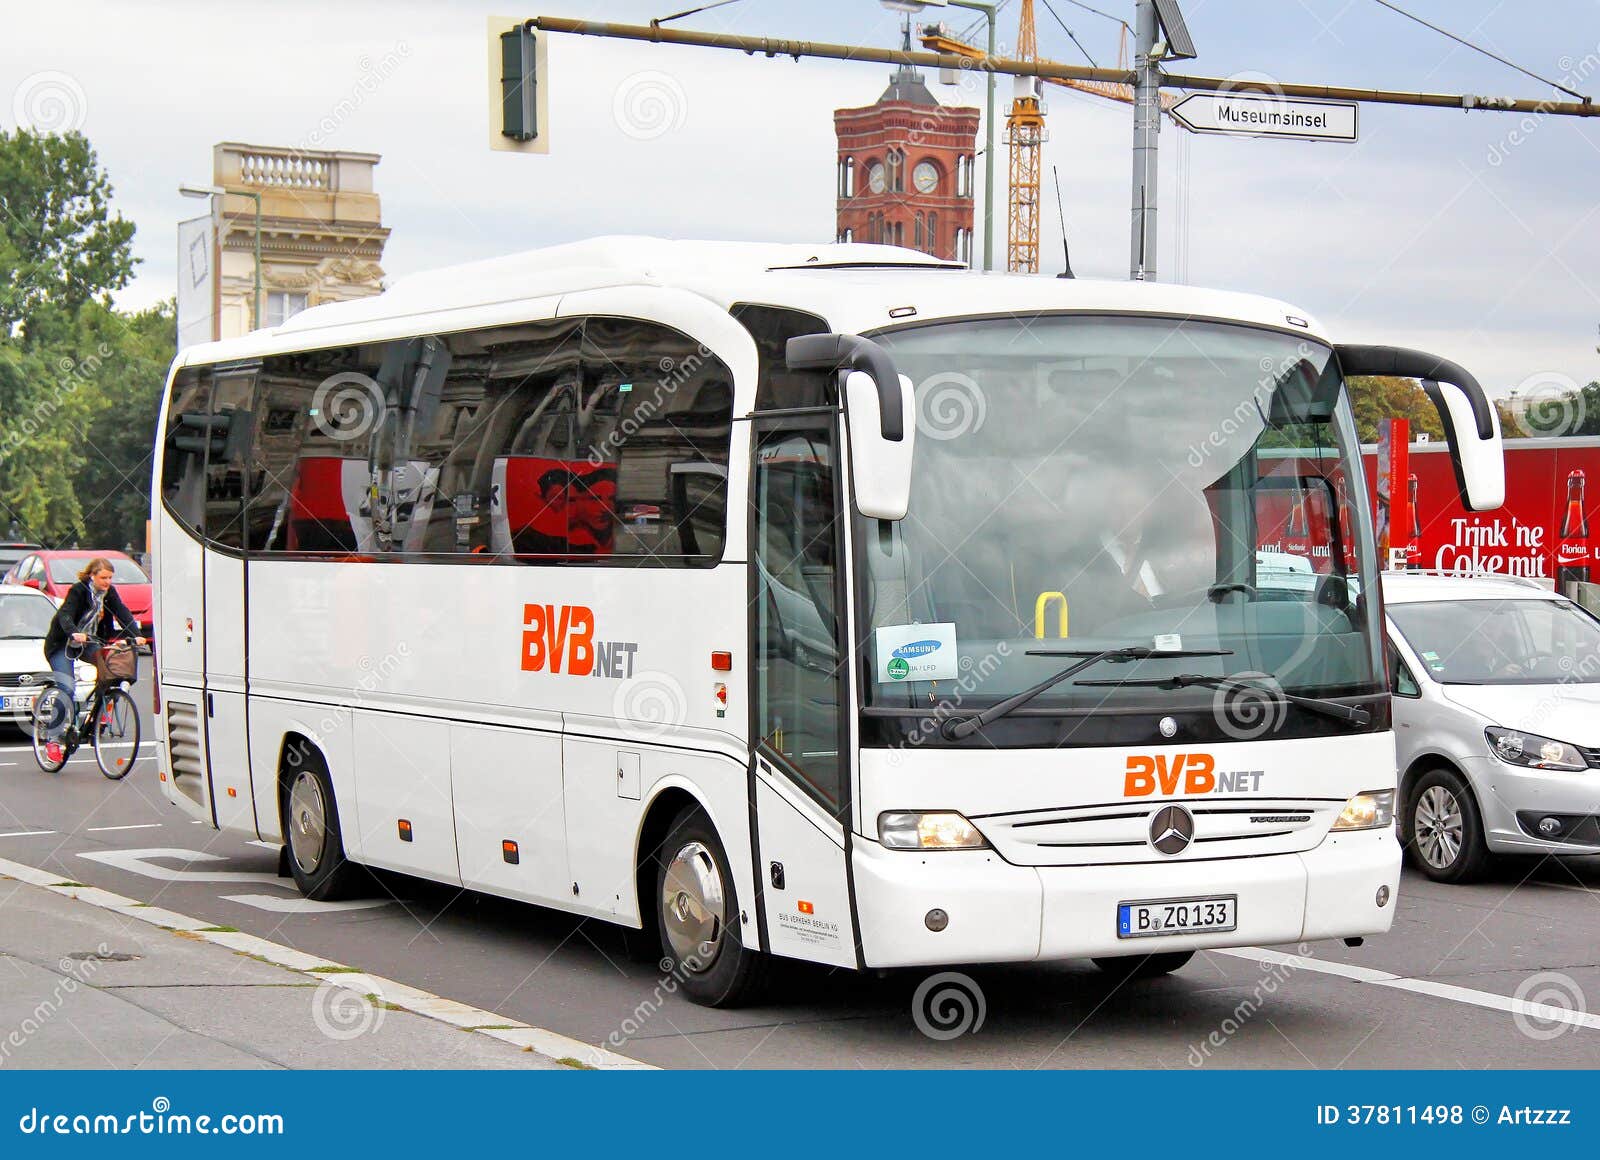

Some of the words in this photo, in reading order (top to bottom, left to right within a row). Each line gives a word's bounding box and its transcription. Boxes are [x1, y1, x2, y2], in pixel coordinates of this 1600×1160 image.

[1219, 105, 1326, 128] Museumsinsel
[1451, 518, 1509, 547] Trink
[1512, 517, 1544, 547] 'ne
[1312, 542, 1331, 557] und
[1435, 544, 1503, 576] Coke
[1508, 548, 1546, 577] mit
[1562, 544, 1587, 554] Florian
[521, 603, 638, 679] BVB.NET
[898, 645, 936, 654] SAMSUNG
[1124, 753, 1264, 797] BVB.NET
[1138, 908, 1150, 929] B
